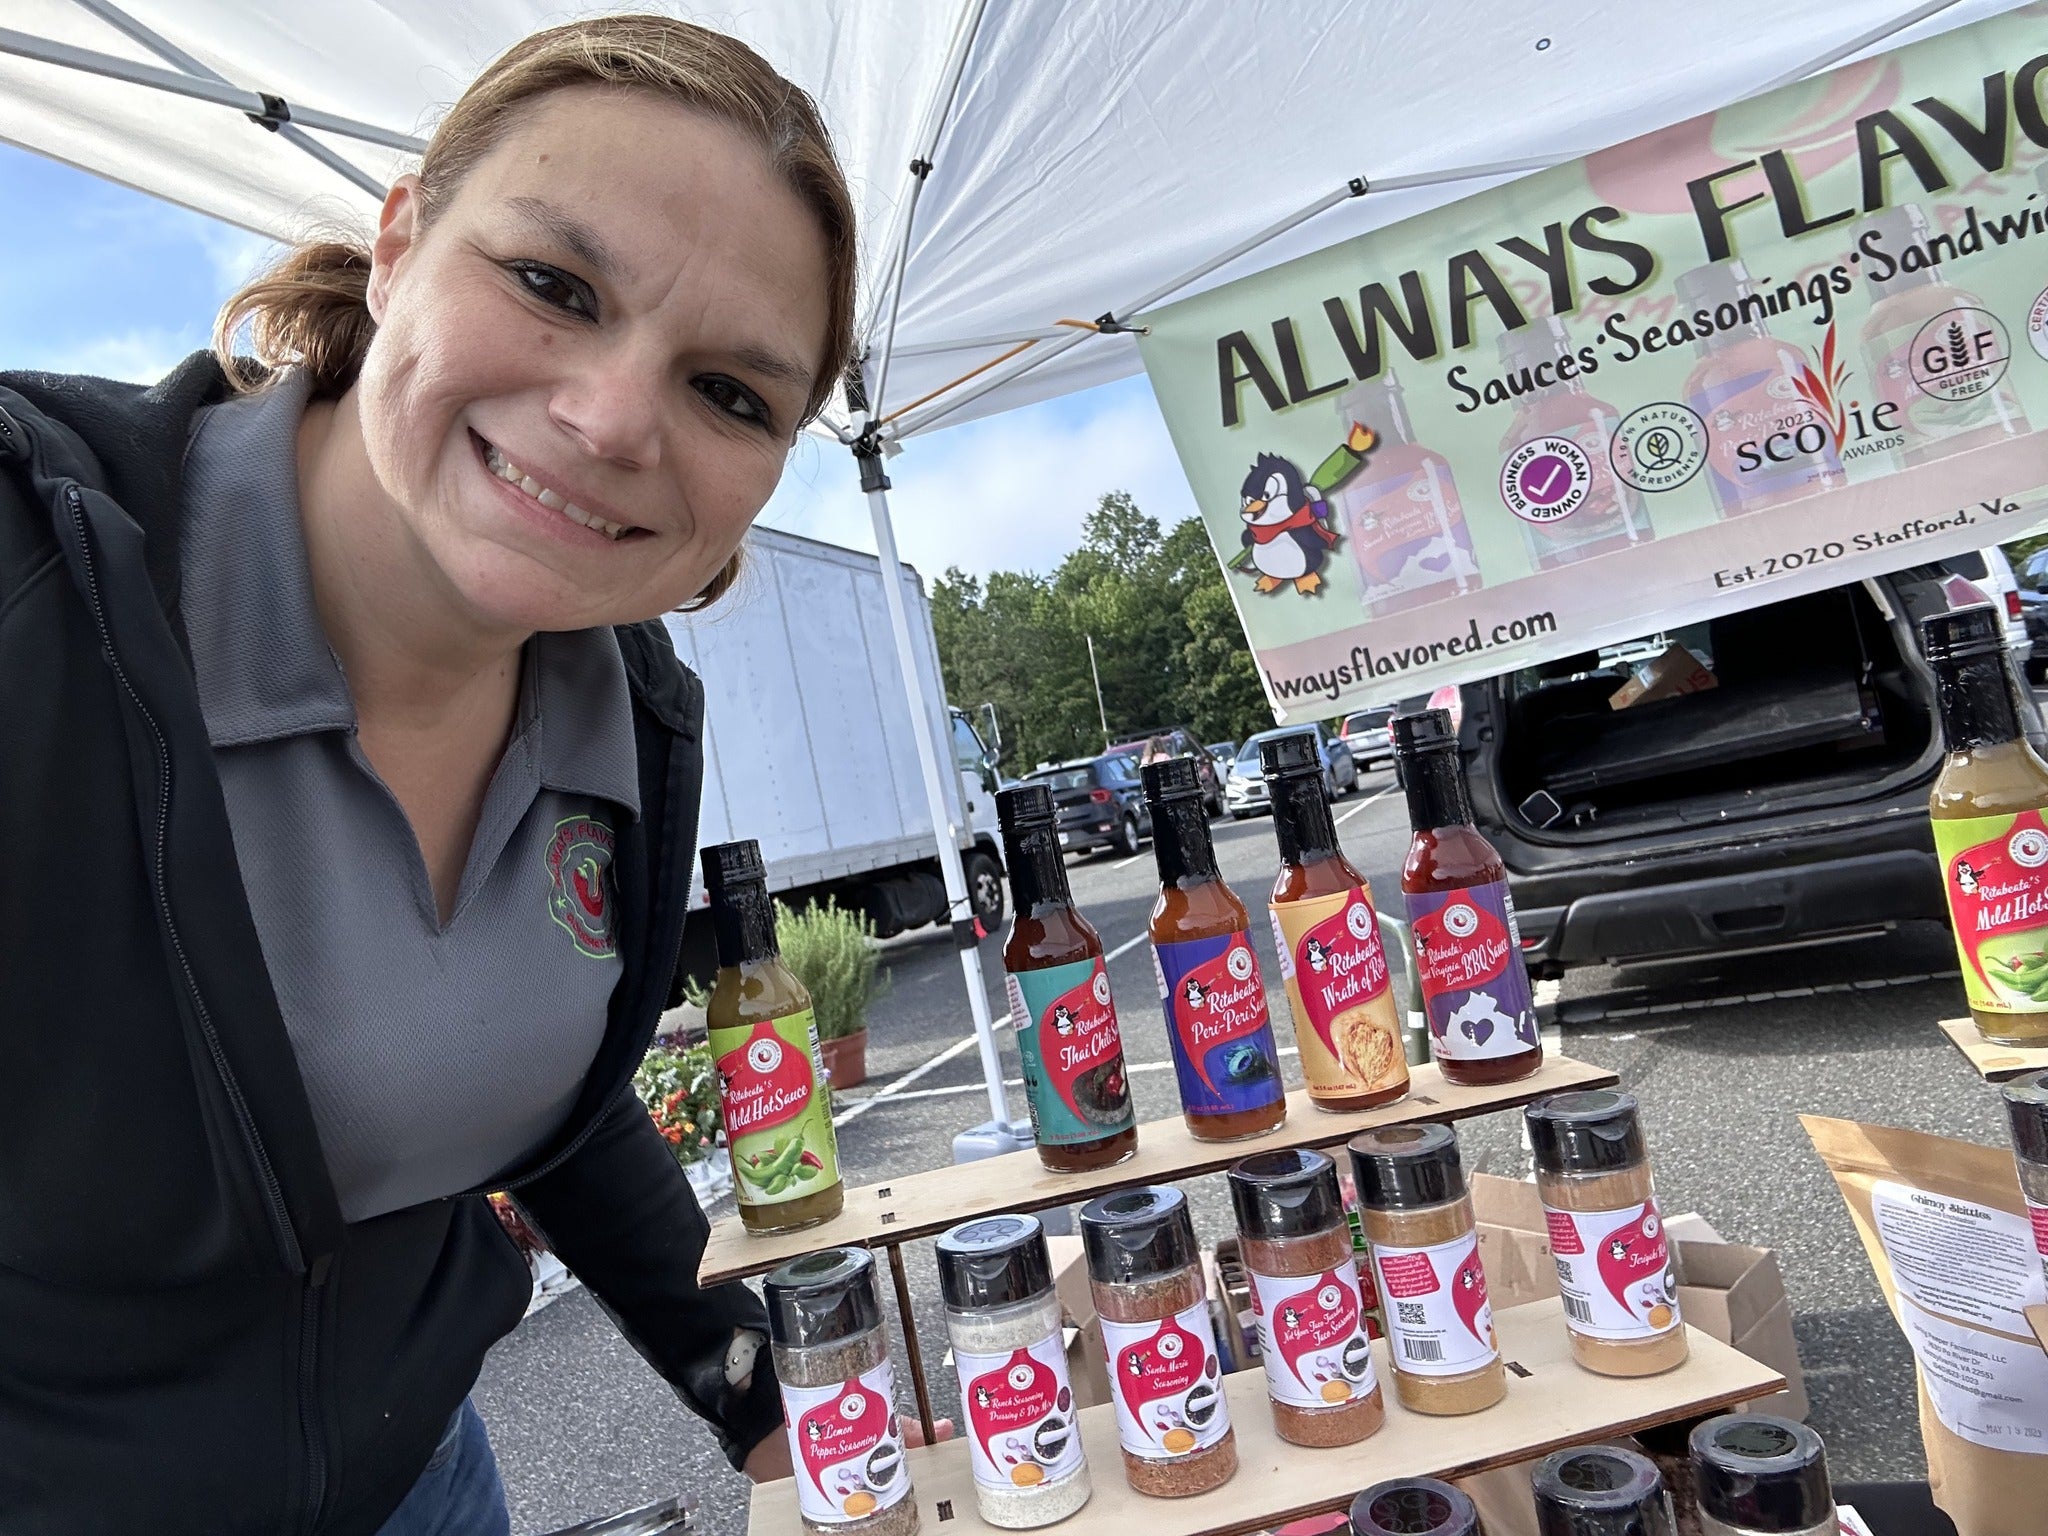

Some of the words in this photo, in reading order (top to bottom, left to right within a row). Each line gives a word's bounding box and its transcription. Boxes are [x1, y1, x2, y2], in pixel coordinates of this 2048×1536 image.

[1217, 206, 1655, 428] ALWAYS
[1447, 345, 1599, 413] Sauces
[1604, 265, 1852, 363] Seasonings
[1939, 368, 1990, 390] GLUTEN
[1951, 381, 1983, 398] FREE
[1640, 410, 1699, 438] NATURAL
[1776, 411, 1814, 431] 2023
[1545, 440, 1588, 481] WOMAN
[1842, 434, 1905, 462] AWARDS
[1505, 446, 1536, 510] BUSINESS
[1627, 450, 1698, 485] INGREDIENTS
[1531, 488, 1582, 519] OWNED
[1852, 509, 1976, 551] Stafford,
[1980, 497, 2021, 516] Va
[1978, 874, 2041, 902] Ritabeata's
[1975, 902, 2012, 931] Mild
[2013, 892, 2044, 921] Hot
[1431, 961, 1461, 978] Virginia
[1461, 944, 1492, 980] BBQ
[1486, 937, 1509, 964] Sauce
[1320, 974, 1361, 1011] Wrath
[1361, 964, 1372, 992] of
[1446, 973, 1465, 986] Love
[1191, 1006, 1250, 1045] Peri-Peri
[1060, 1044, 1091, 1071] Thai
[729, 1079, 774, 1104] Ritabeata's
[729, 1104, 753, 1131] Mild
[752, 1095, 775, 1121] Hot
[774, 1084, 809, 1111] Sauce
[1308, 1319, 1324, 1332] Taco
[1312, 1330, 1331, 1346] Taco
[1144, 1364, 1167, 1377] Santa
[1167, 1359, 1189, 1373] Maria
[1960, 1364, 1971, 1374] VA
[1991, 1353, 2007, 1364] LLC
[1152, 1375, 1189, 1391] Seasoning
[991, 1396, 1013, 1409] Ranch
[1012, 1391, 1044, 1406] Seasoning
[989, 1410, 1018, 1421] Dressing
[1019, 1407, 1026, 1417] &
[824, 1424, 854, 1441] Lemon
[1986, 1424, 2003, 1435] MAY
[810, 1443, 837, 1459] Pepper
[838, 1433, 878, 1455] Seasoning
